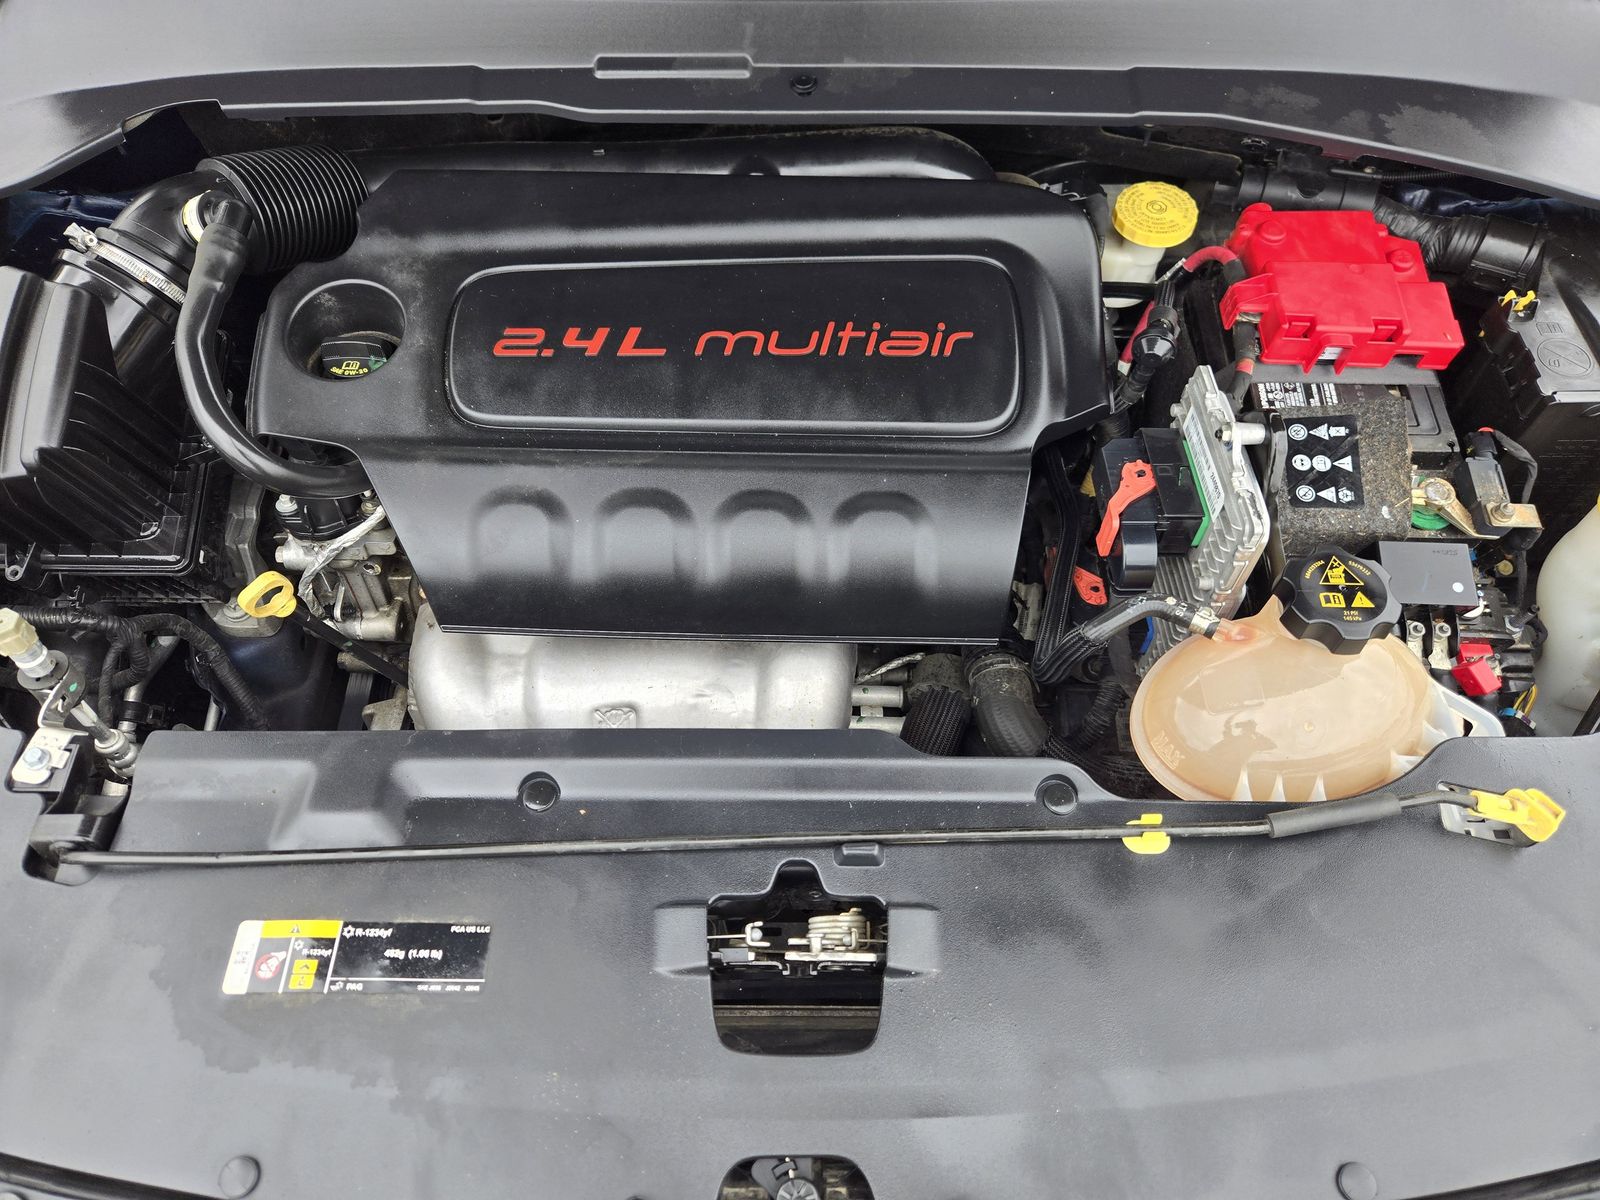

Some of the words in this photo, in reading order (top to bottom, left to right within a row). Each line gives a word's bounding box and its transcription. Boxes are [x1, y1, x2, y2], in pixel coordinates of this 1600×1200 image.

[694, 321, 974, 357] multiair
[330, 366, 344, 375] SAE
[344, 367, 369, 376] 0W-20
[354, 927, 393, 939] R-1234yf
[450, 925, 465, 934] FCA
[465, 925, 476, 934] US
[476, 925, 491, 934] LLC
[345, 982, 363, 991] PAG
